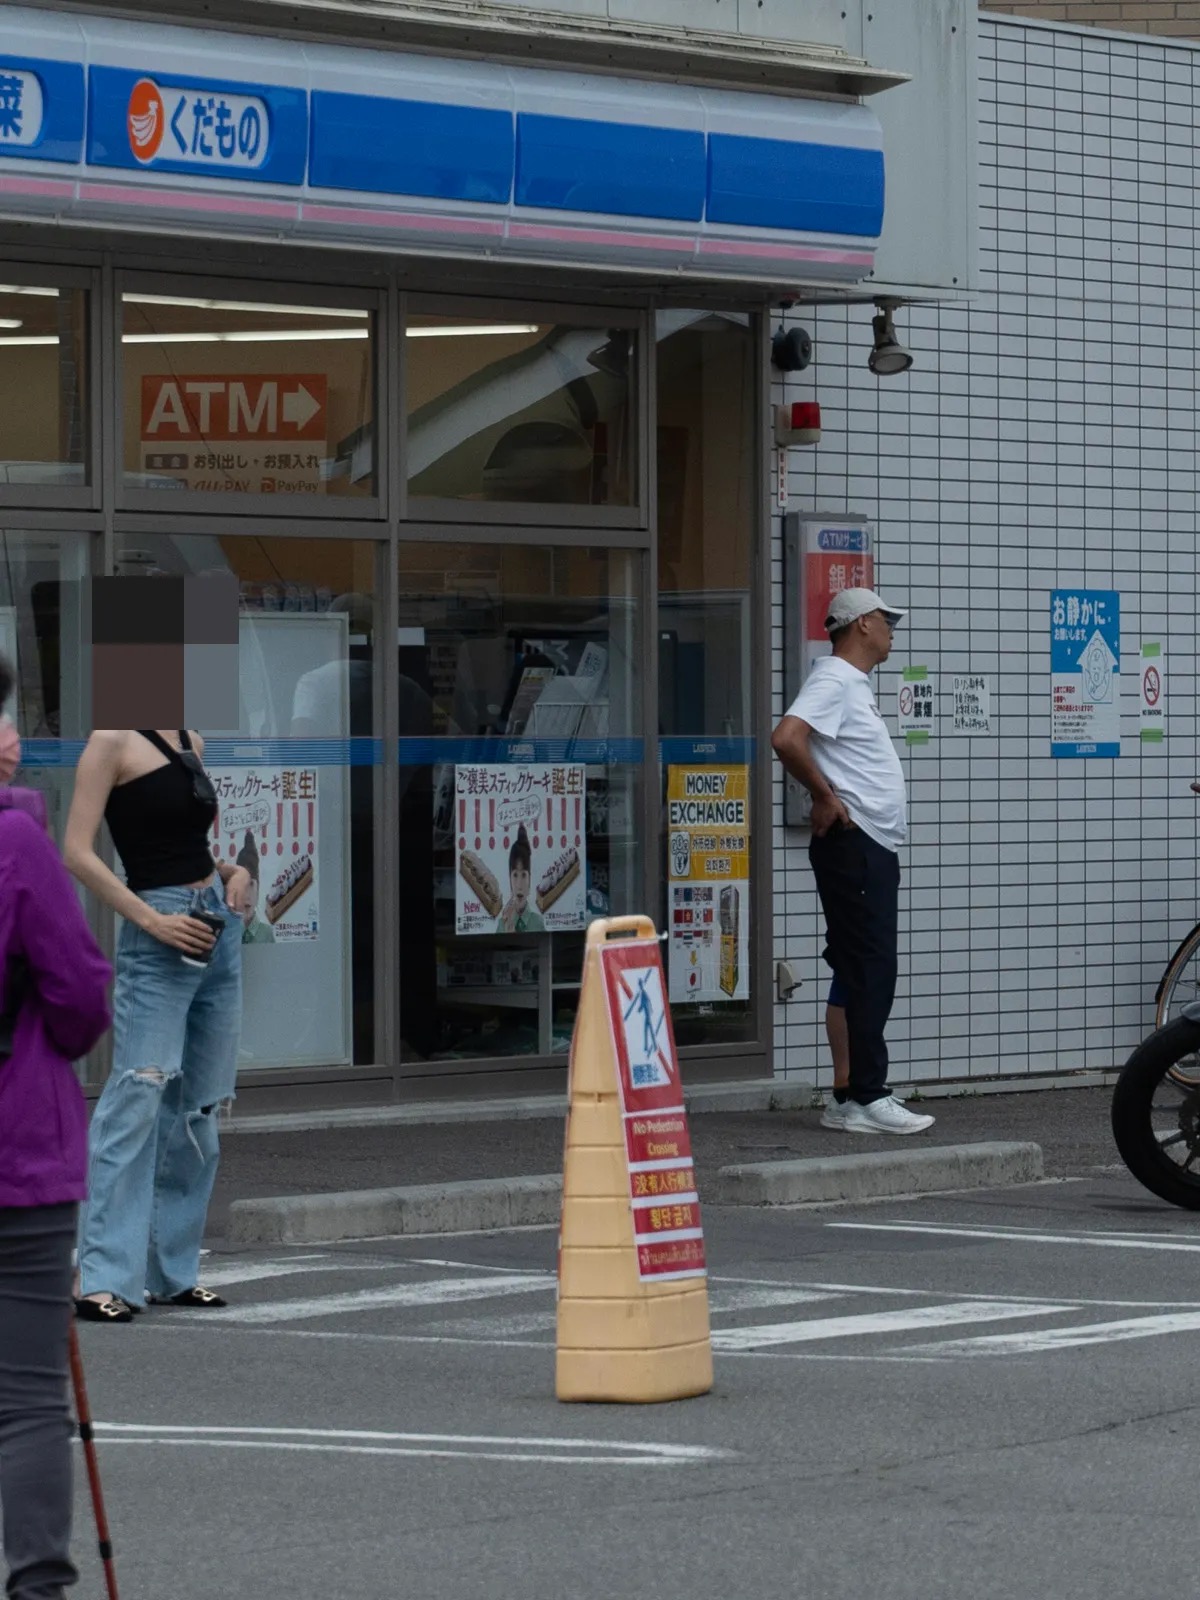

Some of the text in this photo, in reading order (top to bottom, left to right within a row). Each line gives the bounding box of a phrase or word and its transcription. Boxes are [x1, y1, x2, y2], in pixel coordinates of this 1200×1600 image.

[170, 95, 261, 160] くだもの
[146, 381, 278, 433] ATM
[1053, 596, 1106, 626] お静かに
[686, 774, 727, 794] MONEY
[670, 802, 745, 824] EXCHANGE
[633, 1121, 647, 1135] No
